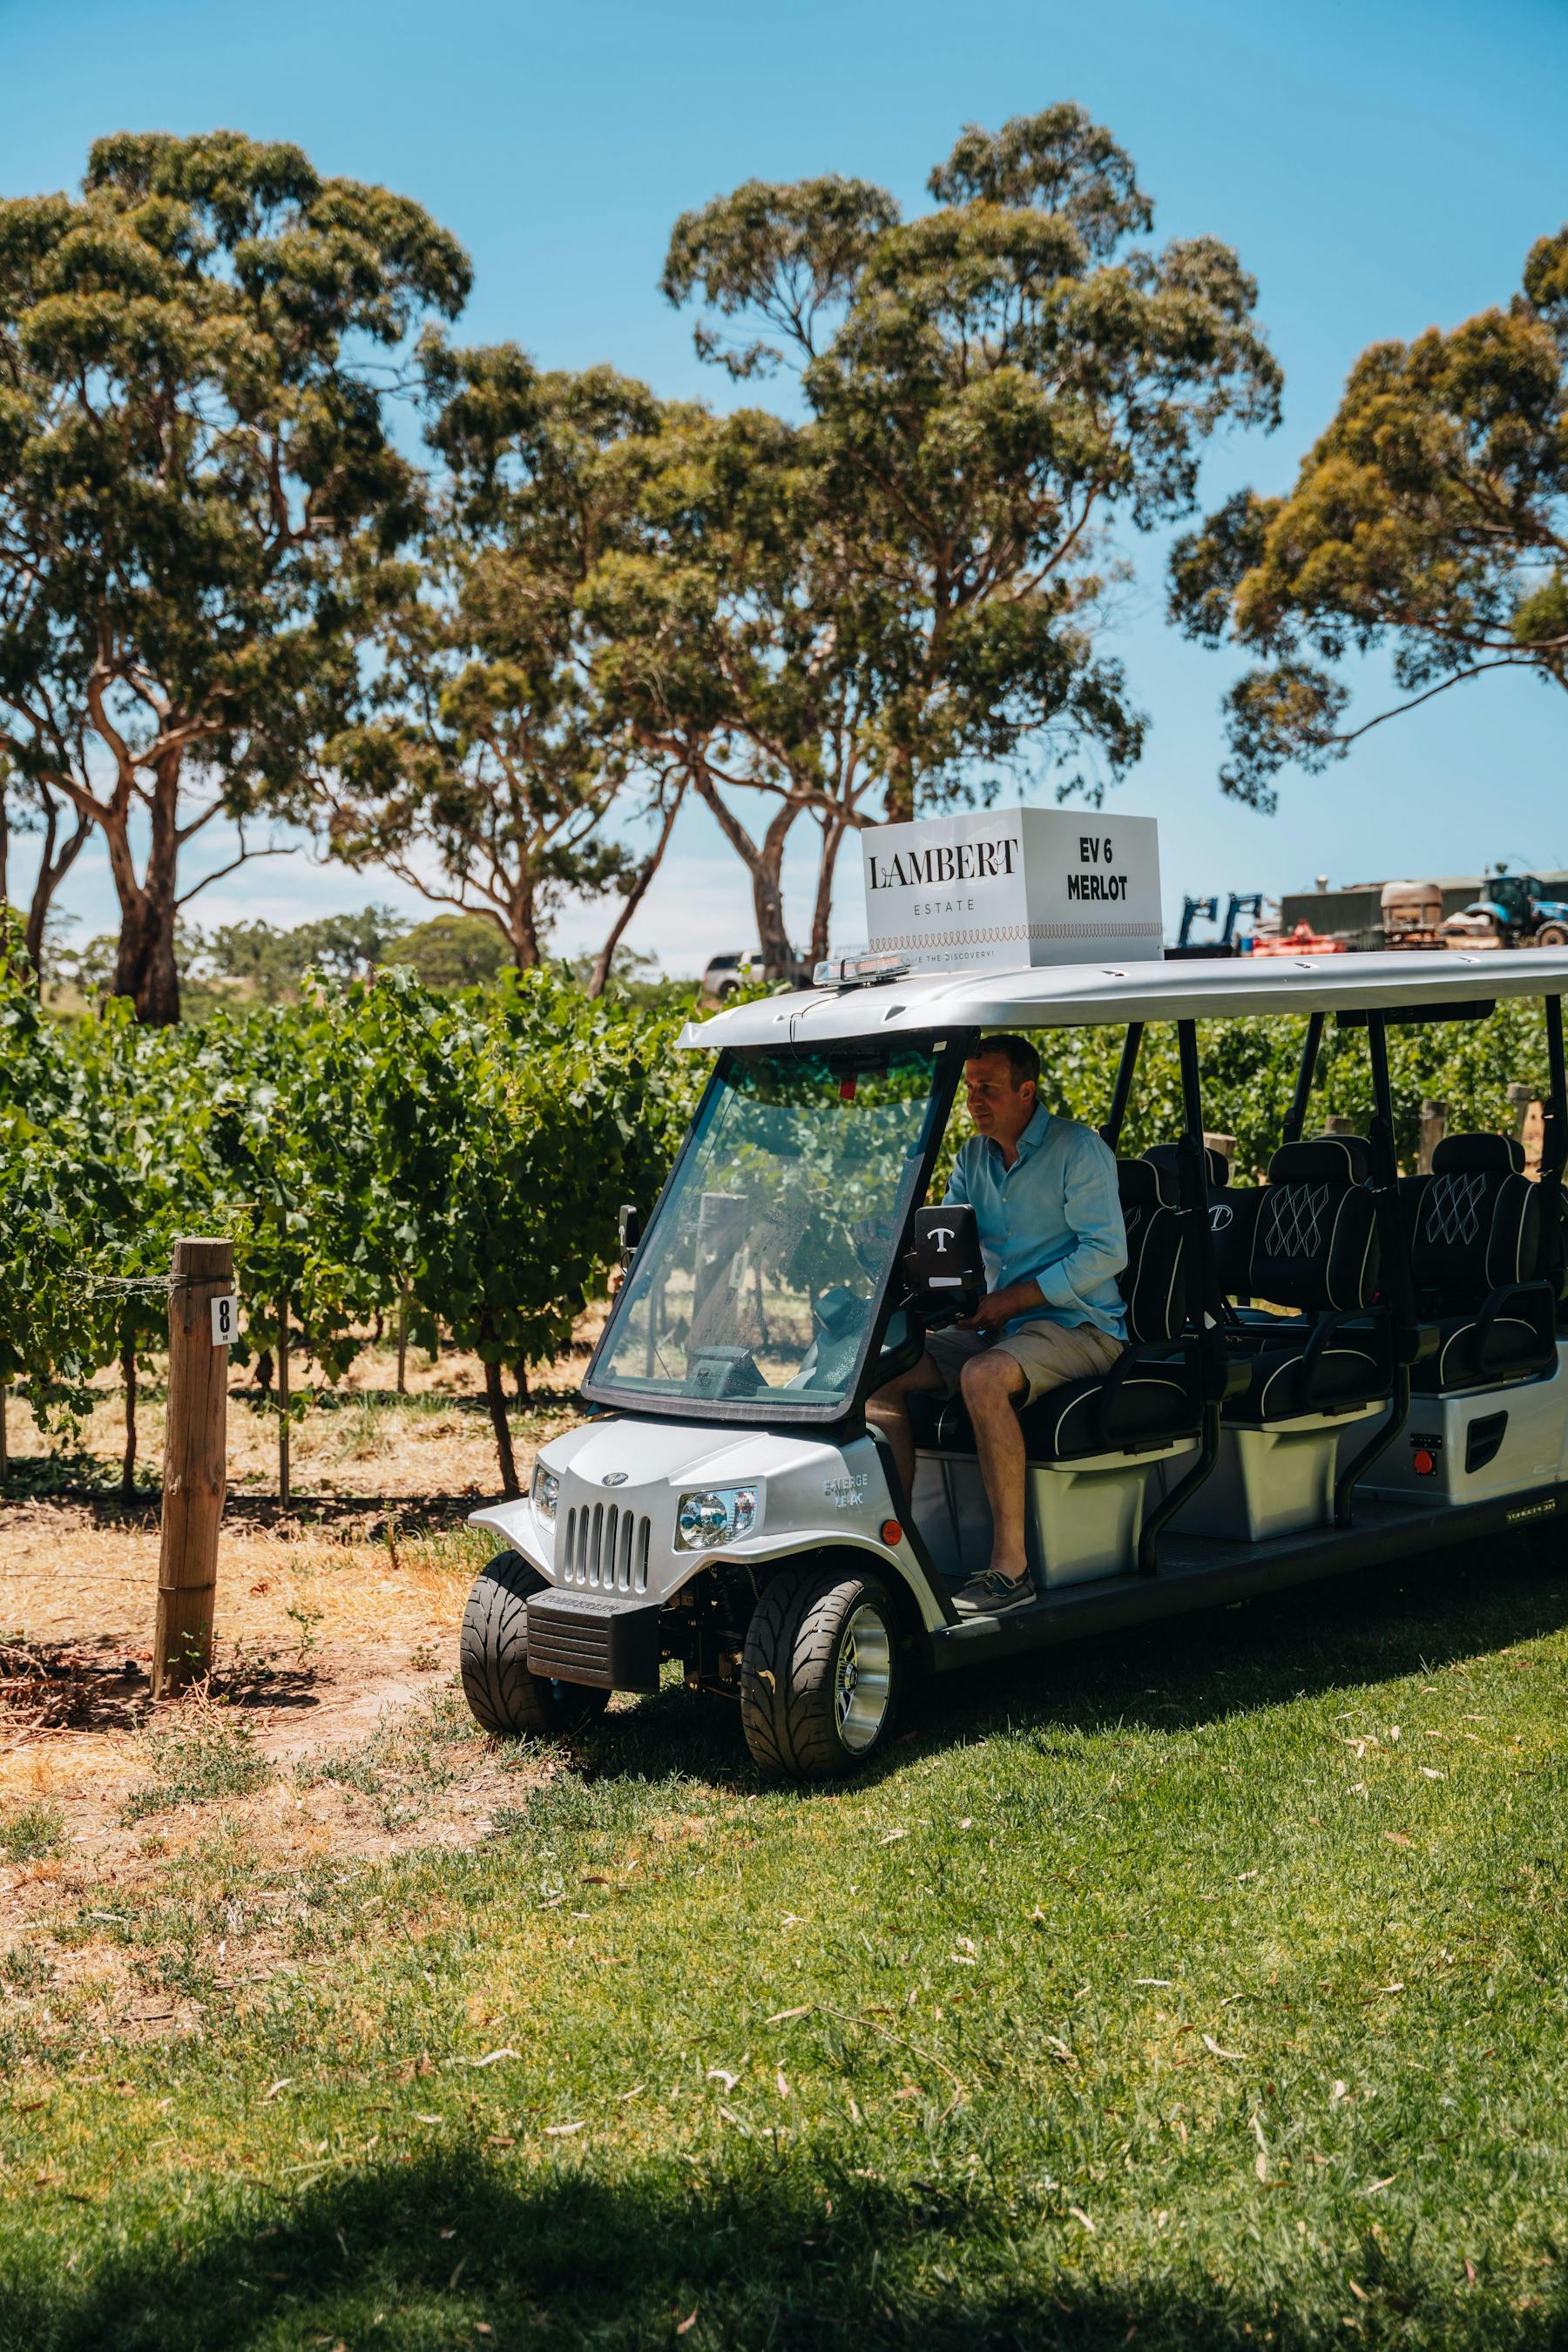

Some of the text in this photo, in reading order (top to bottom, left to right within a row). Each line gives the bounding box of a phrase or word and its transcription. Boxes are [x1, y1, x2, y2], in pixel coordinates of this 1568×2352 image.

[1079, 837, 1112, 863] EV 6
[868, 839, 1018, 889] LAMBERT
[1067, 875, 1127, 901] MERLOT
[915, 899, 975, 916] ESTATE
[926, 954, 942, 963] THE
[927, 1228, 955, 1252] T
[220, 1300, 230, 1333] 8
